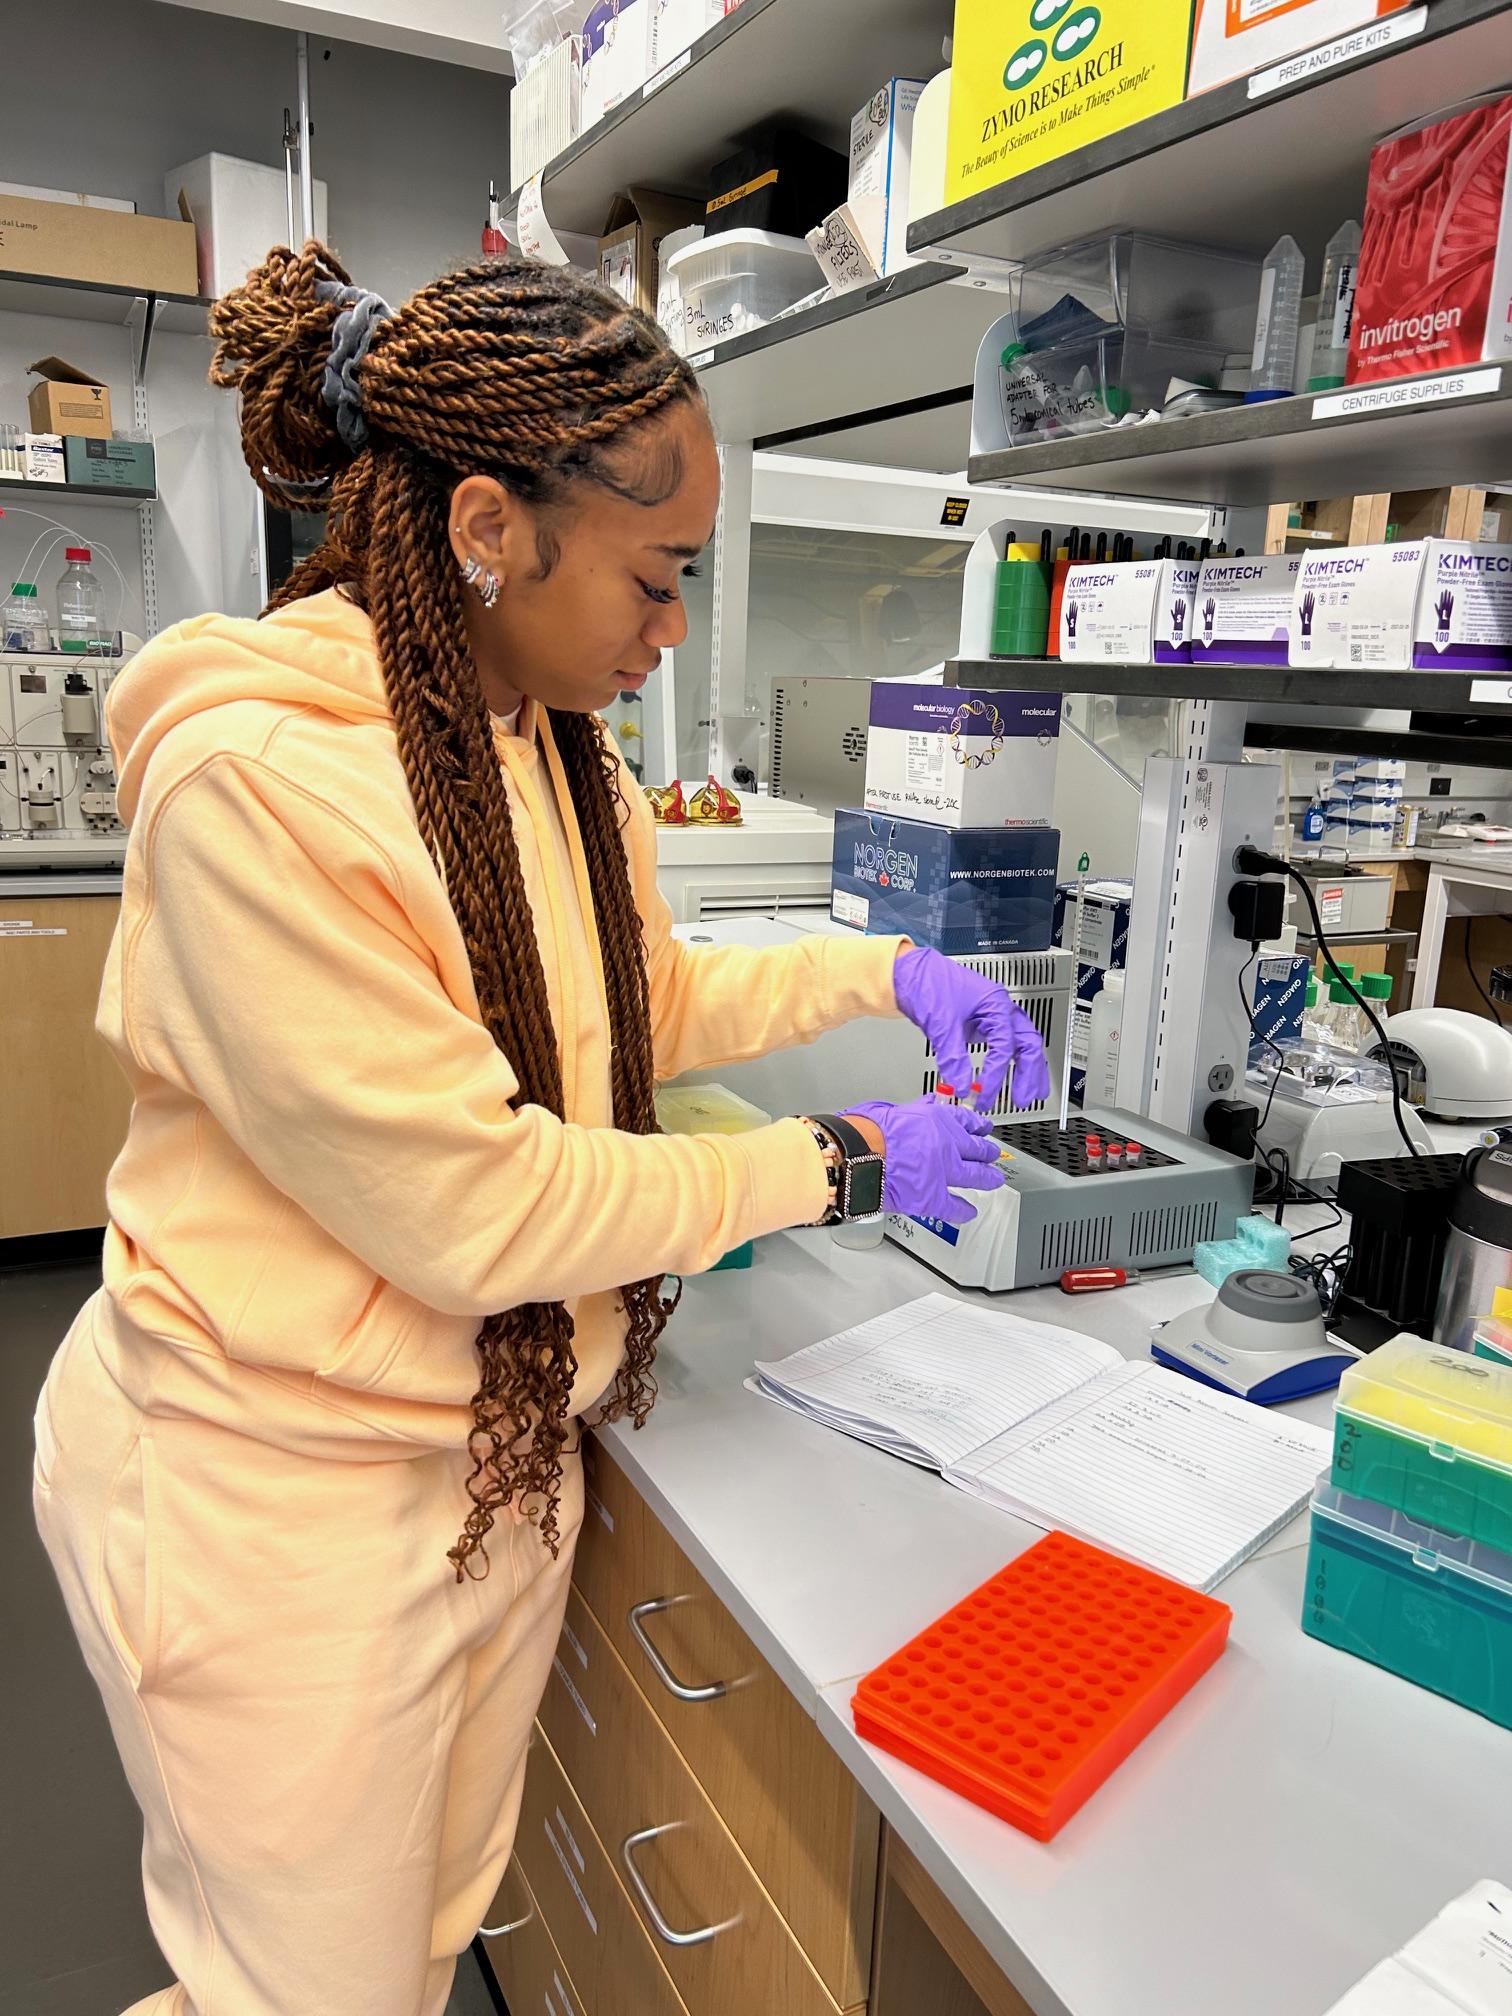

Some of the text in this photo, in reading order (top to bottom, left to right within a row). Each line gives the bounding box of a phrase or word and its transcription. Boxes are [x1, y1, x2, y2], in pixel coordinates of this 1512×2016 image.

[1279, 26, 1391, 82] PREP AND PURE KITS
[981, 40, 1124, 144] ZYMO RESEARCH
[961, 161, 973, 178] The
[975, 148, 1000, 171] Beauty
[1000, 140, 1010, 160] of
[1009, 128, 1039, 152] Science
[1040, 121, 1047, 136] is
[1048, 117, 1057, 131] to
[1058, 102, 1083, 127] Make
[1085, 87, 1115, 113] Things
[0, 218, 14, 227] dal
[686, 299, 706, 325] 3mL
[697, 313, 735, 338] SYRINGES
[1358, 306, 1462, 350] invitrogen
[1357, 339, 1451, 368] by Thermo Fisher Scientific
[1005, 373, 1049, 391] UNIVERSAL
[1006, 382, 1057, 402] ADAPTER FOR
[1342, 379, 1464, 411] CENTRIFUGE SUPPLIES
[1067, 397, 1095, 415] tubes
[1392, 550, 1420, 562] 55083
[1134, 568, 1155, 579] 55081
[1204, 566, 1263, 580] KIMTECH
[1304, 559, 1365, 576] KIMTECH
[1437, 570, 1479, 578] Purple Nitrile
[1069, 574, 1115, 588] KIMTECH
[1436, 578, 1476, 586] Powder-Free
[1171, 632, 1183, 641] 100
[1202, 631, 1213, 641] 100
[1435, 631, 1449, 643] 100
[1300, 641, 1311, 651] 100
[913, 703, 955, 715] molecular biology
[1022, 707, 1057, 716] molecular
[853, 841, 919, 879] NORGEN
[853, 865, 878, 883] BIOTEK
[950, 868, 1055, 880] WWW.NORGENBIOTEK.COM
[1078, 966, 1096, 989] QIAGEN
[1277, 979, 1302, 1007] QIAGEN
[1252, 994, 1272, 1020] IAGEN
[1191, 1343, 1229, 1366] Mini Vortexer
[1429, 1355, 1489, 1379] 200
